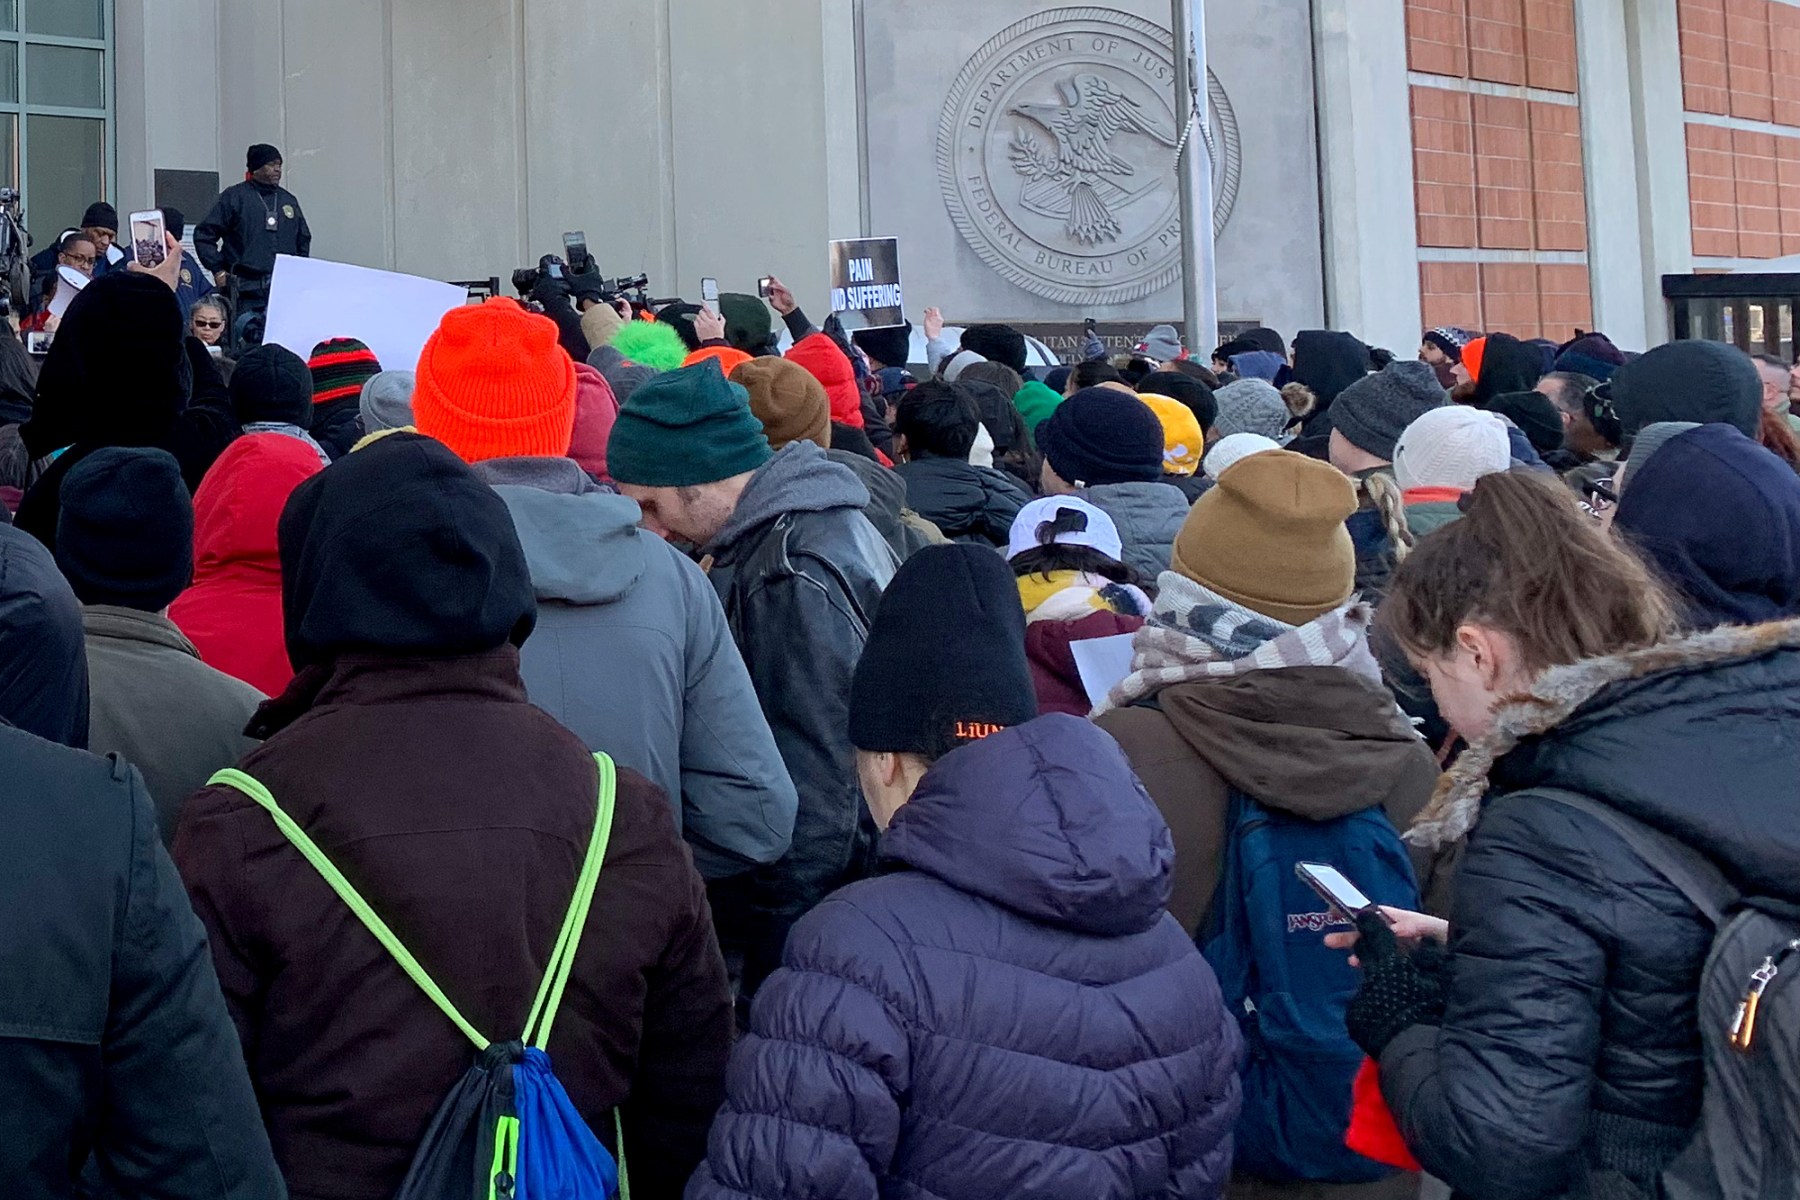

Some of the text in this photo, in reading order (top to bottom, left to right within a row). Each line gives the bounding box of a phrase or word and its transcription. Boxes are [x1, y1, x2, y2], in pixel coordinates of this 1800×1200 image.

[968, 37, 1175, 130] DEPARTMENT OF JUST
[968, 175, 1150, 275] FEDERAL BUREAU OF
[831, 283, 901, 312] ND SUFFERING
[848, 257, 874, 282] PAIN
